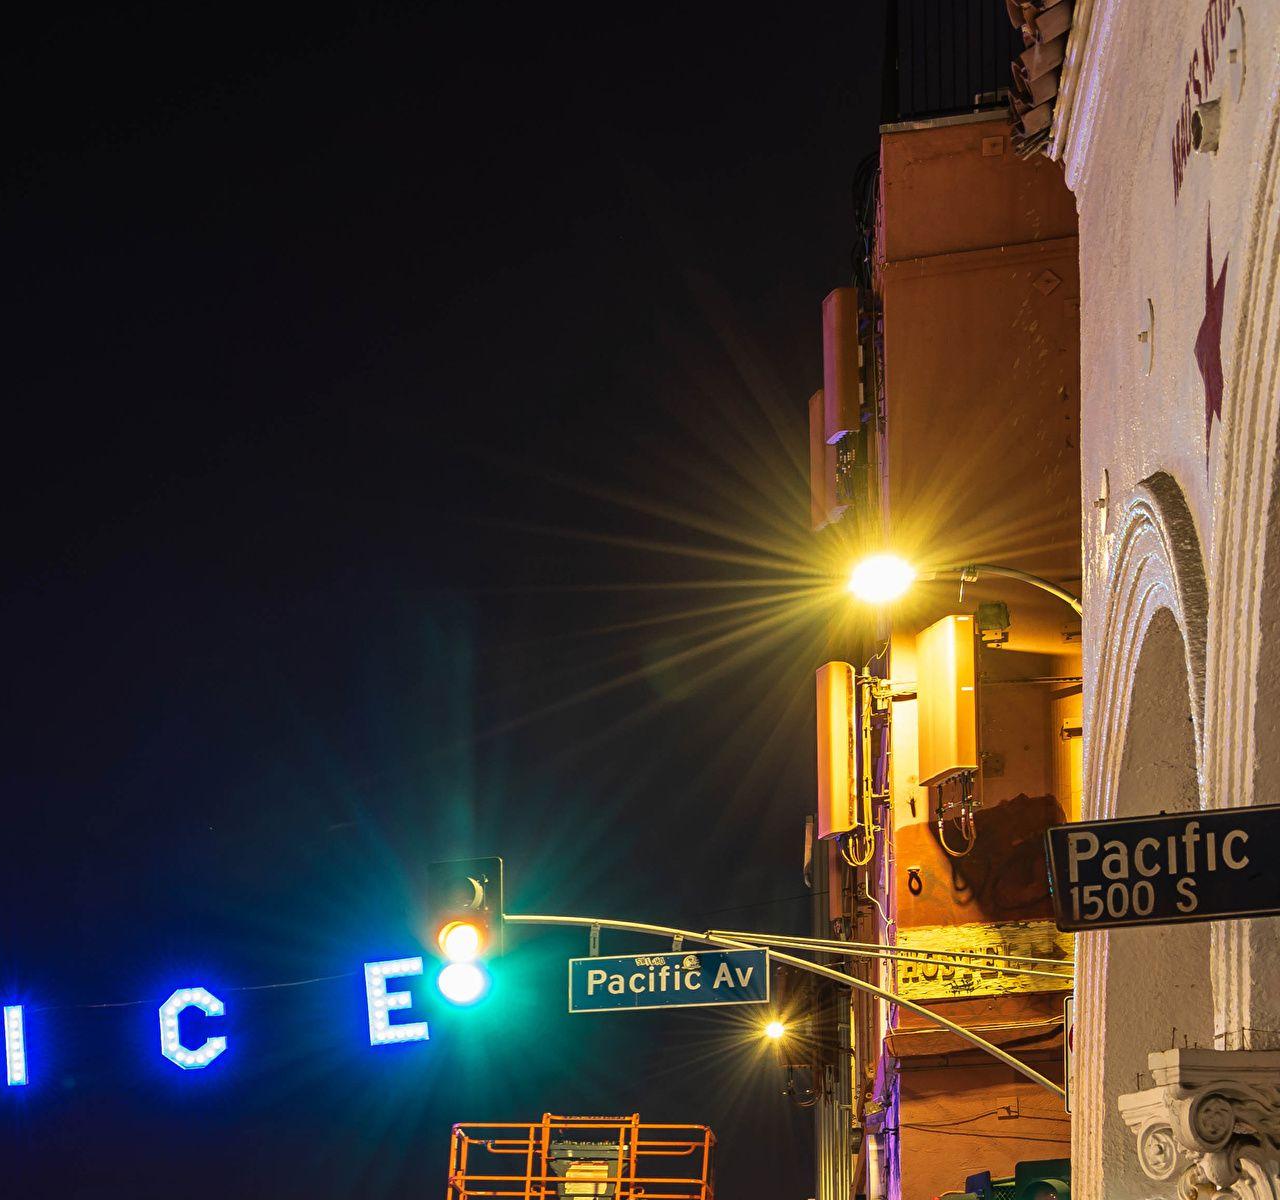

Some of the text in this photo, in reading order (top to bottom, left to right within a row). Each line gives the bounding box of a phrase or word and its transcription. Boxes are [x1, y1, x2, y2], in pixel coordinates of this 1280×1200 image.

[1067, 820, 1250, 883] Pacific
[1069, 877, 1199, 921] 1500 S
[587, 962, 754, 996] Pacific Av
